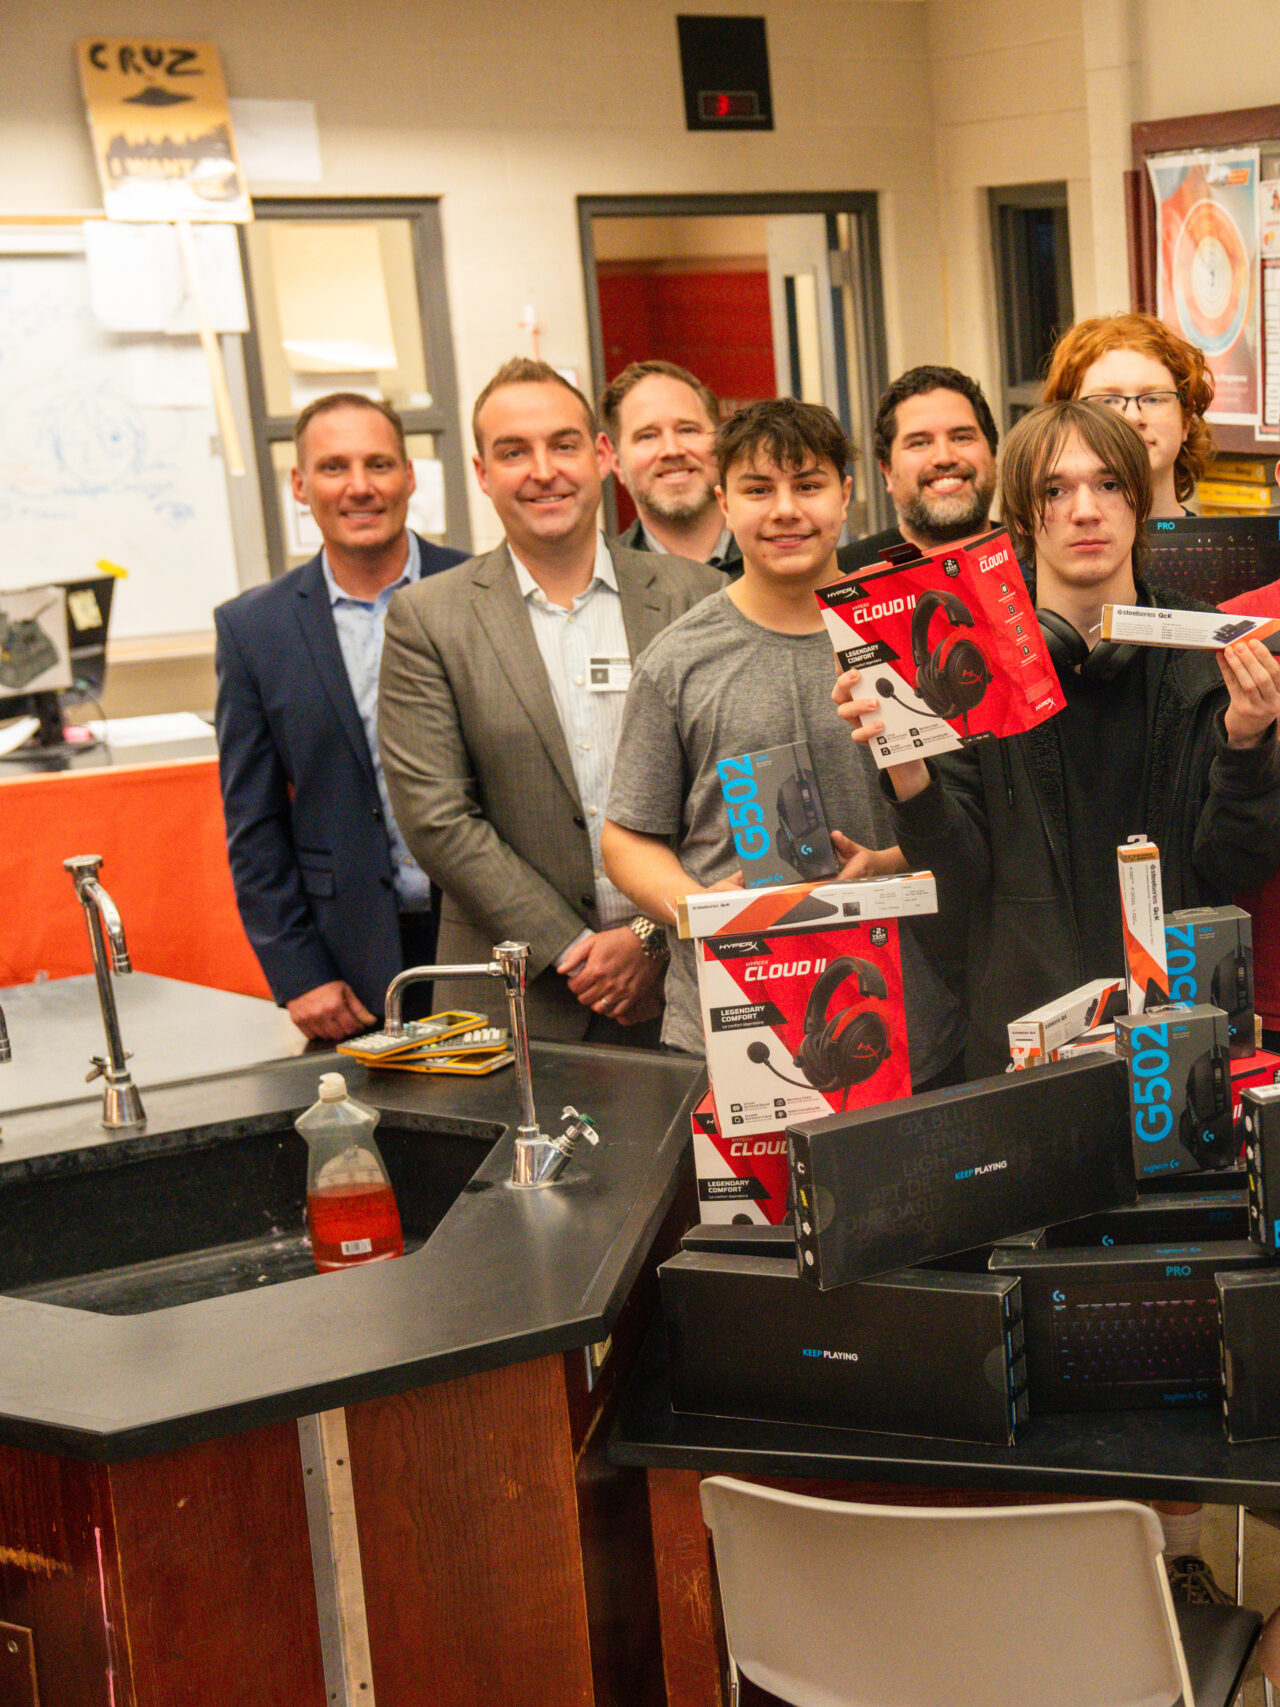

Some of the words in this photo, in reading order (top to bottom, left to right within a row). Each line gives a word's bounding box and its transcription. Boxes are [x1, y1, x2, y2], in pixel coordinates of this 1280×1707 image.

[89, 42, 204, 77] CRUZ
[1157, 521, 1175, 531] PRO
[979, 552, 1004, 573] CLOUD
[853, 598, 904, 625] CLOUD
[906, 594, 917, 610] II
[845, 644, 879, 658] LEGENDARY
[847, 652, 875, 664] COMFORT
[716, 753, 770, 860] G502
[719, 940, 760, 952] HYPERX
[744, 960, 811, 982] CLOUD
[814, 958, 827, 974] II
[1165, 923, 1197, 1007] 502
[720, 1005, 765, 1016] LEGENDARY
[721, 1013, 758, 1023] COMFORT
[1131, 1022, 1173, 1143] G502
[955, 1168, 974, 1181] KEEP
[974, 1160, 1008, 1175] PLAYING
[1144, 1163, 1168, 1173] logitech
[1166, 1265, 1191, 1276] PRO
[802, 1349, 822, 1357] KEEP
[823, 1351, 858, 1361] PLAYING
